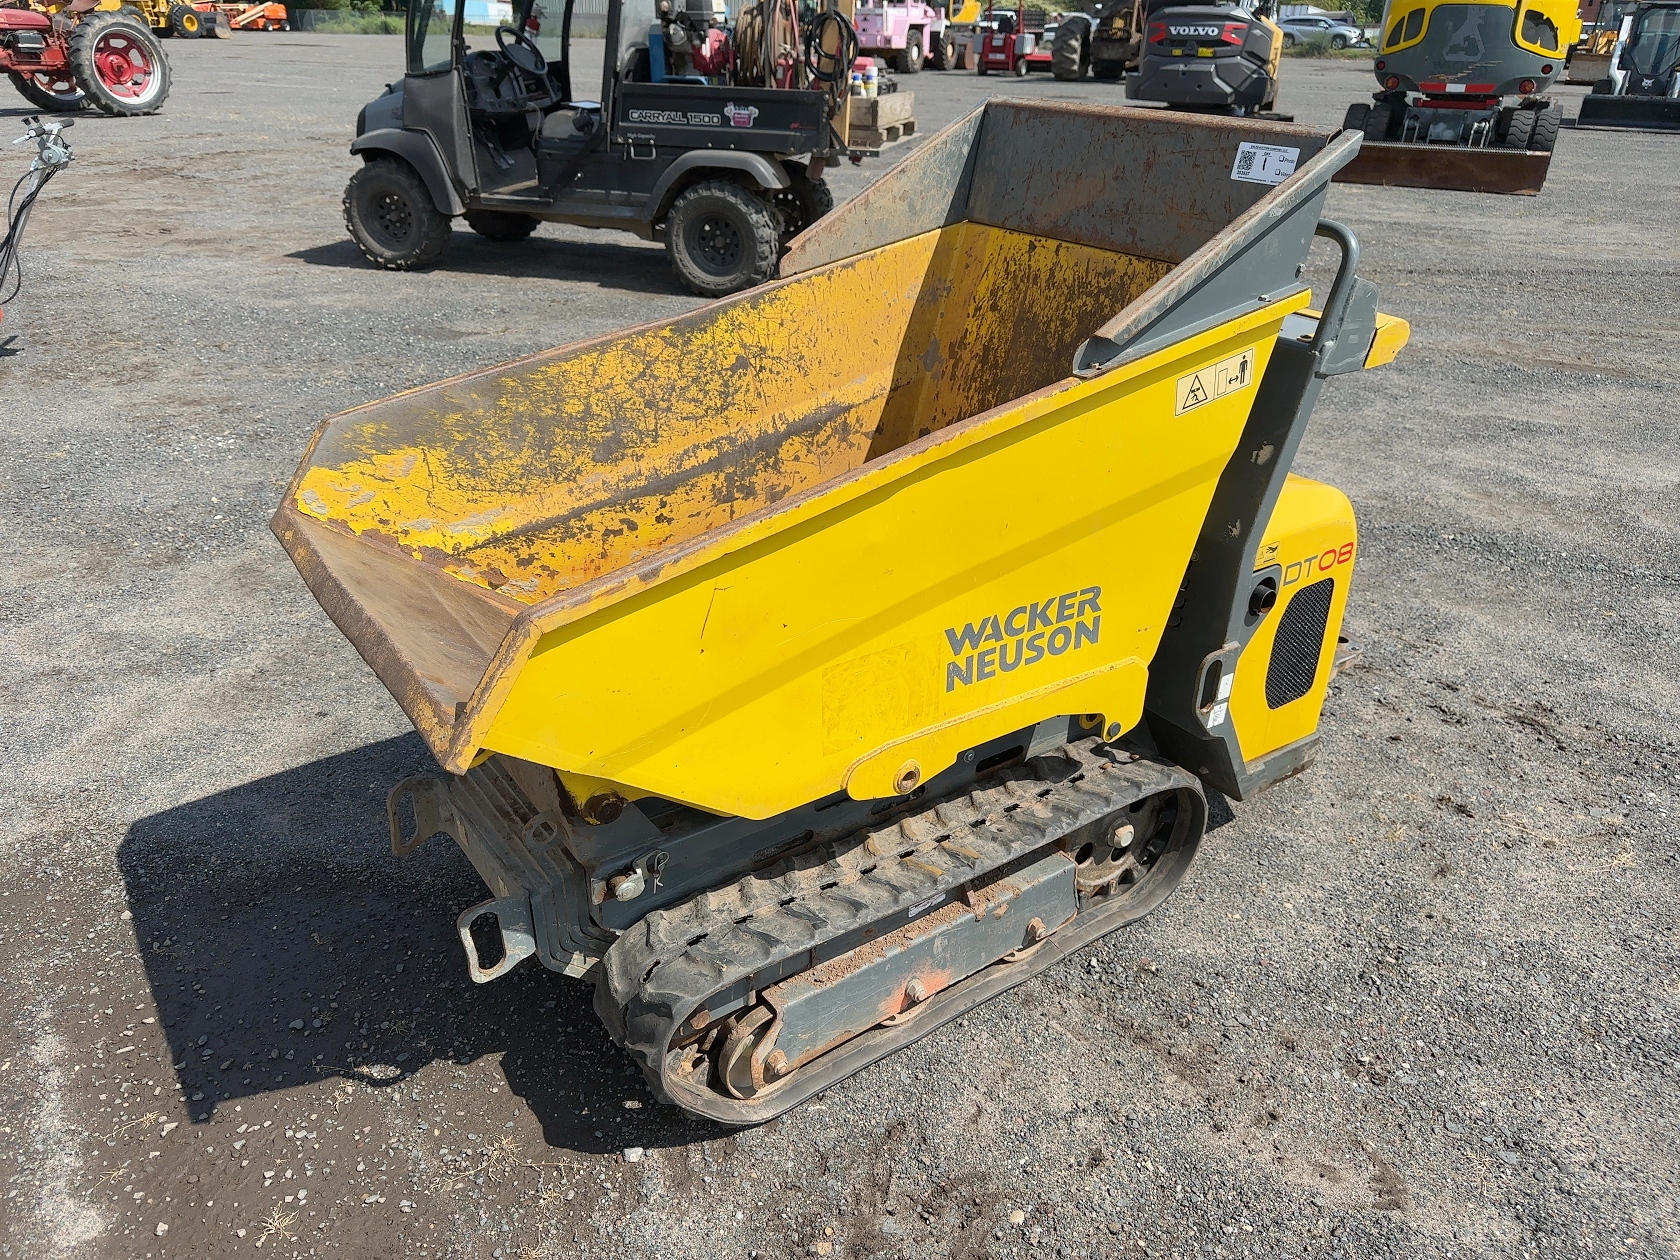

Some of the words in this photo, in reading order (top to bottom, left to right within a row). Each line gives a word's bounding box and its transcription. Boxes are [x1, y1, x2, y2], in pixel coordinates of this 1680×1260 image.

[1169, 26, 1219, 36] VOLVO
[629, 110, 688, 124] CARRYALL
[687, 112, 721, 125] 1500
[1283, 541, 1354, 586] DT08
[944, 585, 1102, 656] WACKER
[946, 615, 1101, 693] NEUSON
